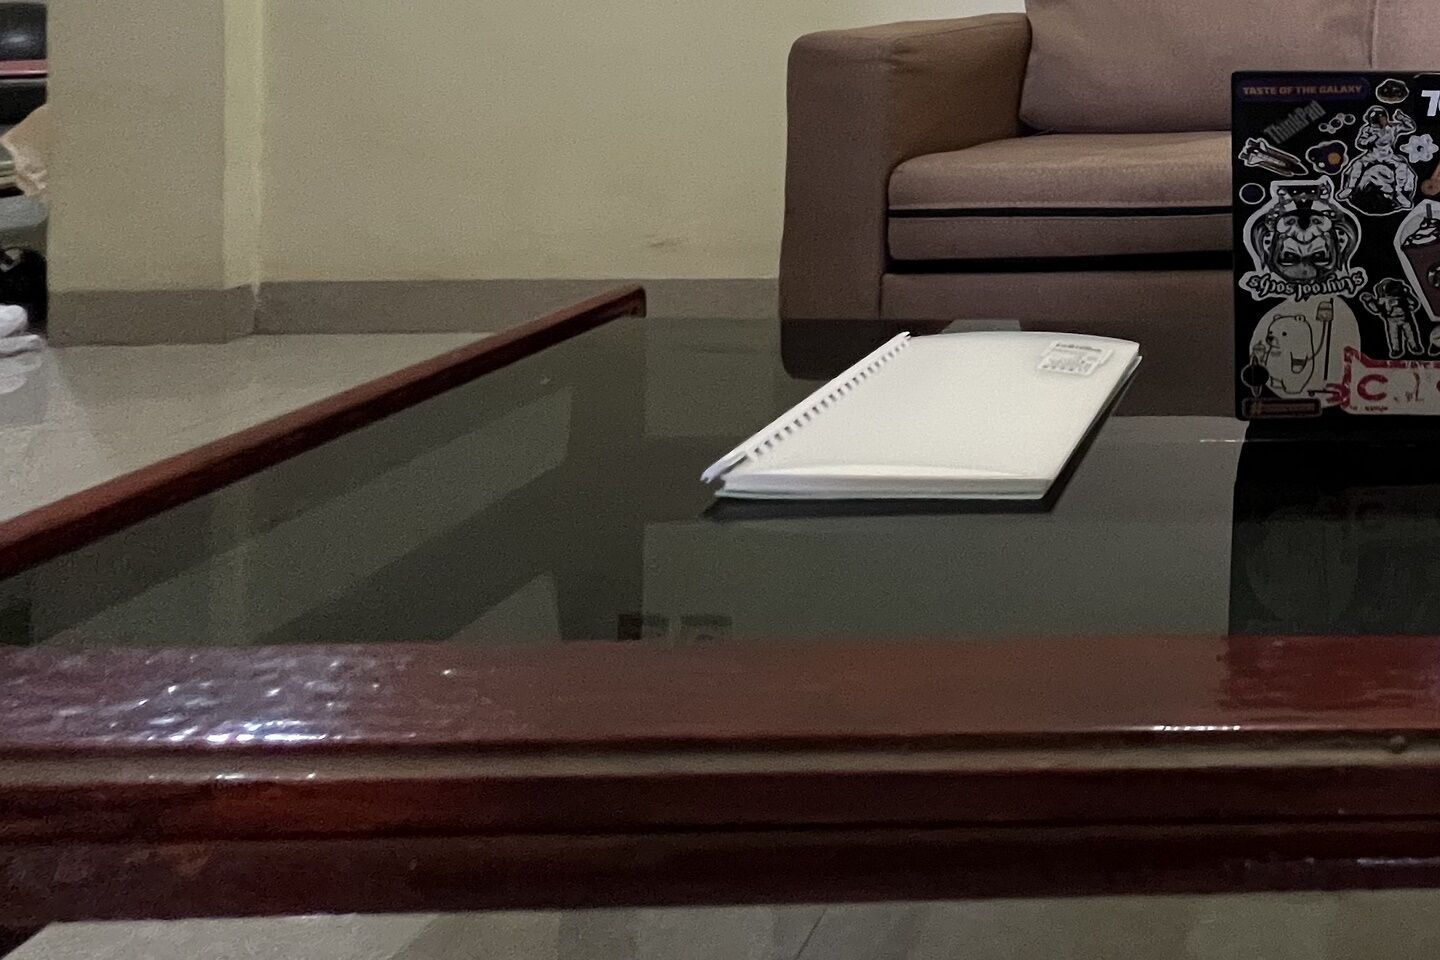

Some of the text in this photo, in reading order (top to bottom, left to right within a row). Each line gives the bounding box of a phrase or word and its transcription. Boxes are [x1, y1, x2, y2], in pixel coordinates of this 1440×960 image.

[1242, 85, 1363, 96] TASTE OF THE GALAXY
[1263, 100, 1327, 144] ThinkPad
